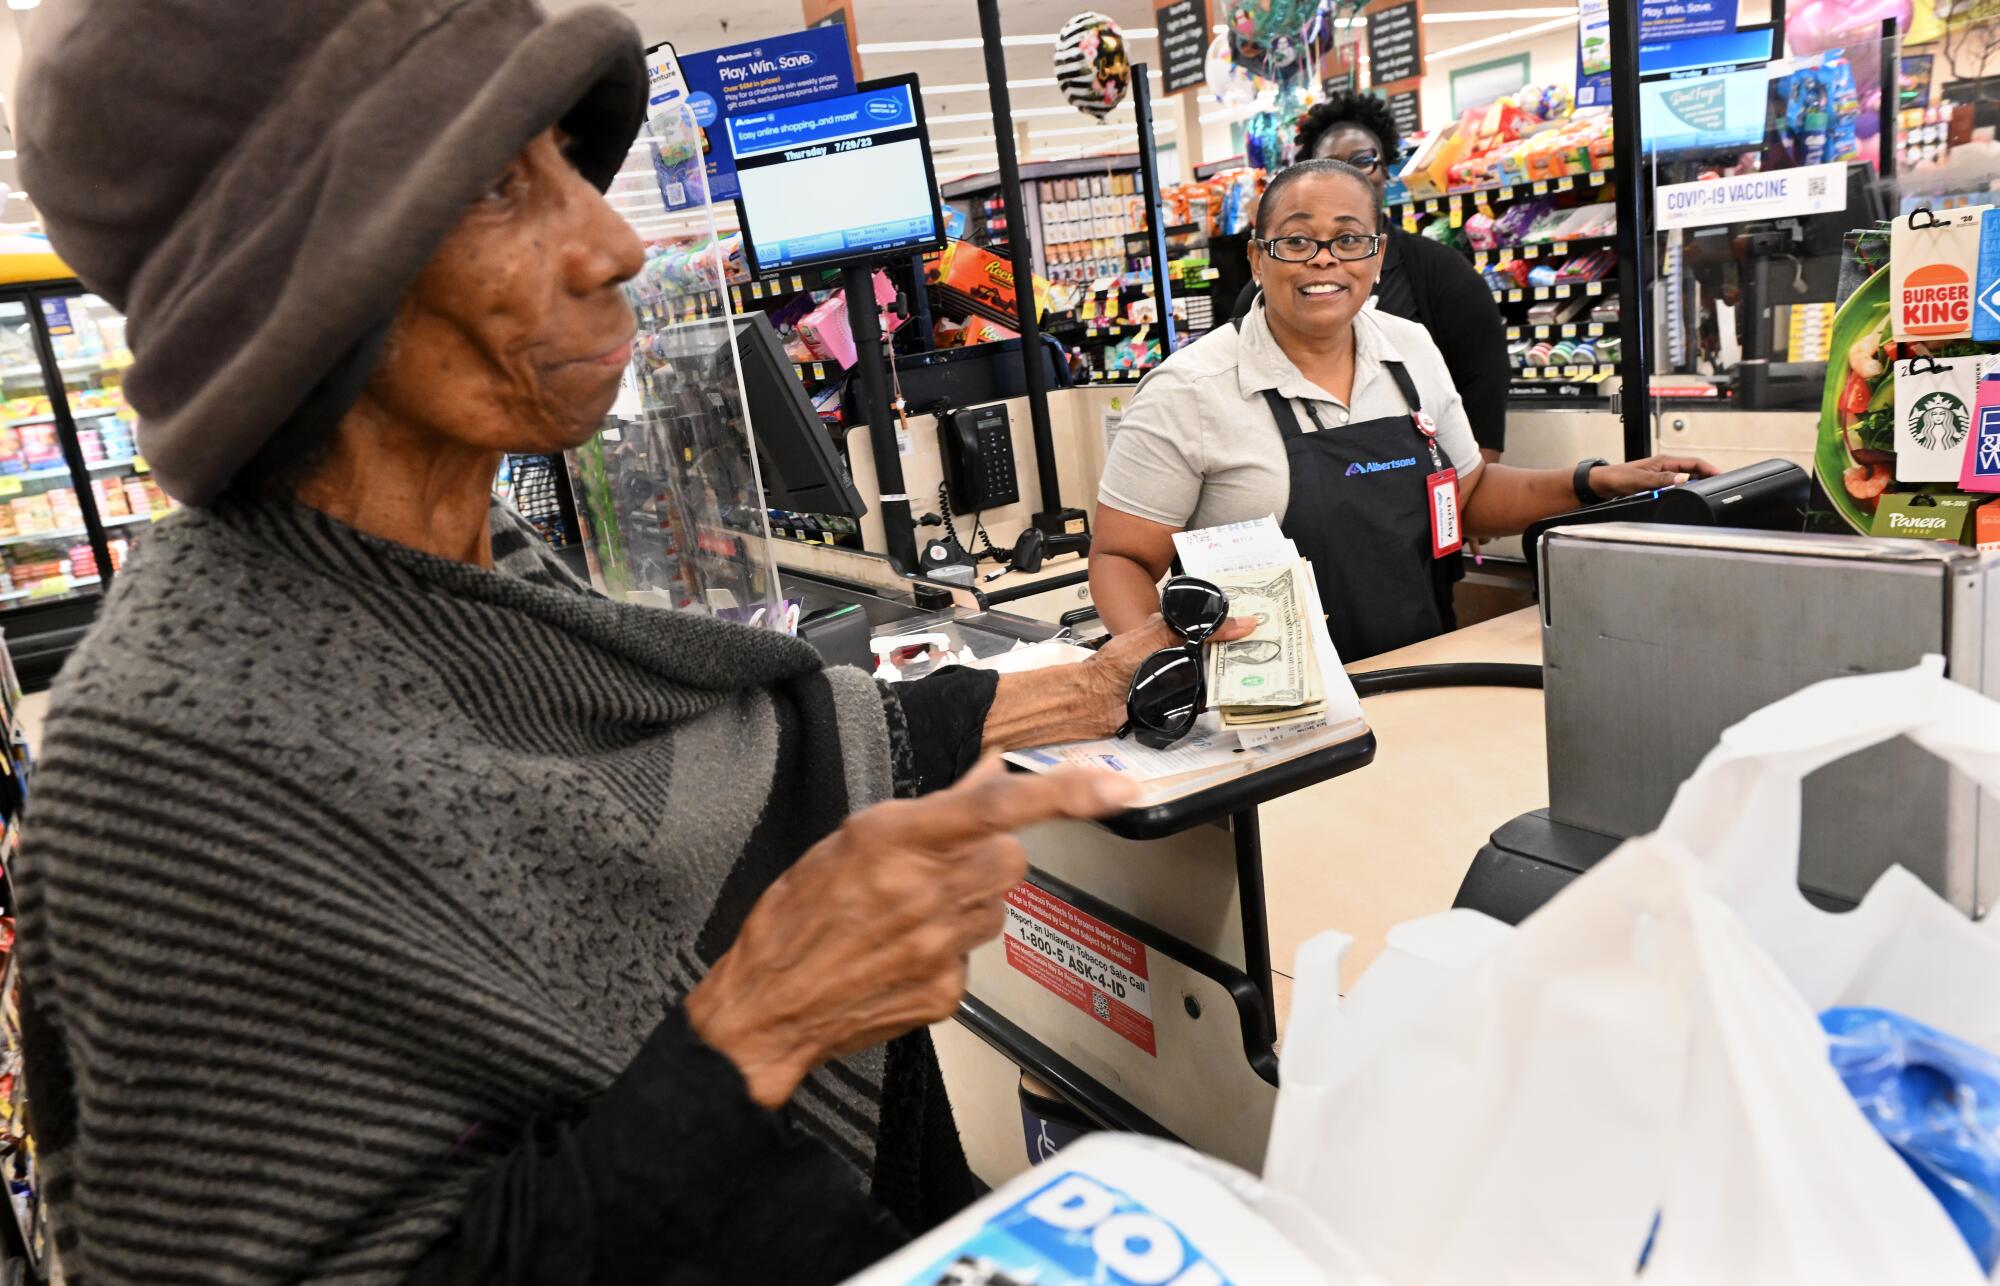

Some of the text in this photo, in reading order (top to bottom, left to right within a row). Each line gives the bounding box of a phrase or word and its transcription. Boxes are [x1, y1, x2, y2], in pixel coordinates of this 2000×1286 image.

[719, 53, 813, 81] Play. Win. Save.
[754, 86, 777, 97] chance
[738, 130, 757, 142] Easy
[757, 125, 779, 137] online
[784, 147, 828, 161] Thursday
[1729, 178, 1788, 202] VACCINE
[1903, 285, 1969, 304] BURGER
[1903, 301, 1969, 325] KING
[1366, 457, 1416, 473] Albertsons
[1889, 512, 1947, 528] Panera
[1026, 889, 1046, 906] Tobacco
[1045, 899, 1068, 917] Products
[1073, 914, 1094, 932] Persons
[1095, 926, 1112, 942] Under
[1111, 936, 1120, 946] 21
[1121, 939, 1137, 955] Years
[1028, 902, 1052, 920] Prohibited
[1052, 914, 1059, 925] by
[1059, 919, 1070, 930] Law
[1080, 929, 1100, 948] Subject
[1100, 941, 1106, 951] to
[1107, 944, 1132, 965] Penalties
[1010, 908, 1033, 928] Report
[1034, 923, 1042, 934] an
[1044, 927, 1075, 952] Unlawful
[1076, 945, 1108, 972] Tobacco
[1109, 965, 1127, 983] Sale
[1129, 976, 1146, 993] Call
[1020, 927, 1064, 963] 1-800-5
[1068, 955, 1126, 998] ASK-4-ID
[1023, 1172, 1224, 1286] DO
